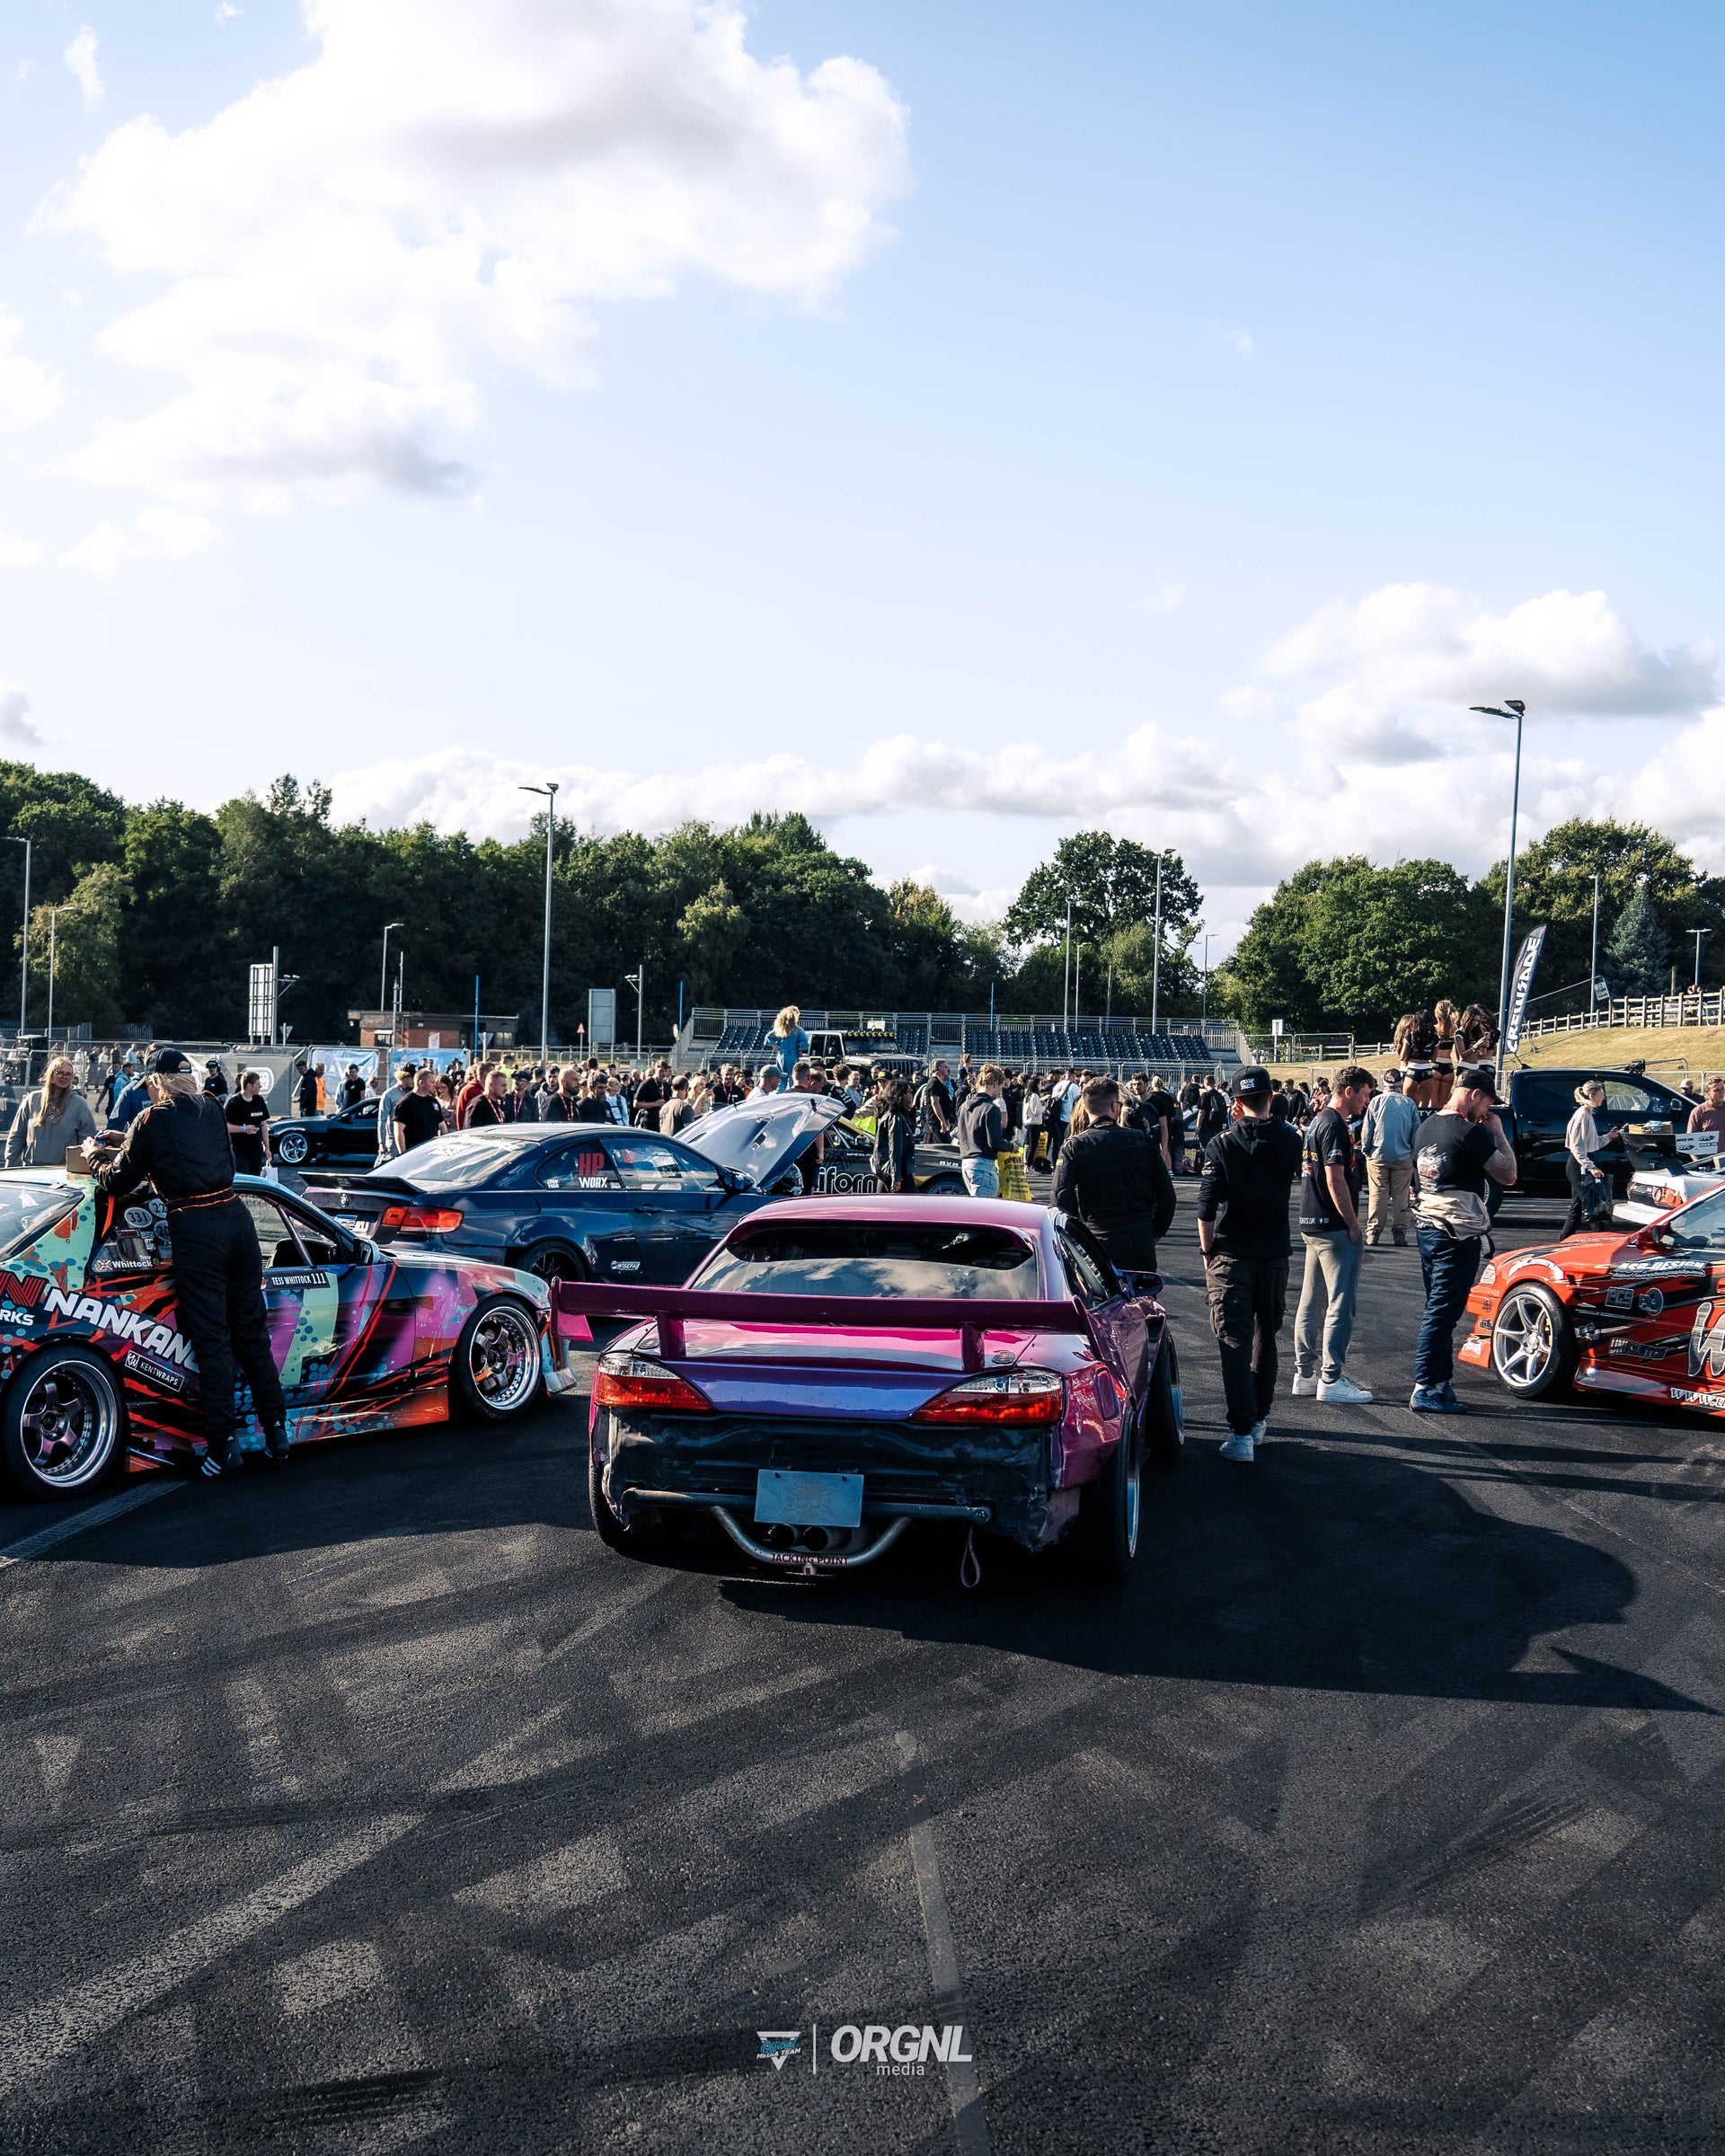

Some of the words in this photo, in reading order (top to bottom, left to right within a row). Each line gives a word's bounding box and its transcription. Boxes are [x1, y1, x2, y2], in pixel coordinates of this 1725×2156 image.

[579, 1153, 605, 1177] HP
[579, 1177, 607, 1188] WORX
[128, 1211, 149, 1223] 331
[111, 1259, 153, 1269] Whittock
[271, 1277, 285, 1286] TESS
[284, 1275, 312, 1285] WHITTOCK
[311, 1273, 326, 1284] 111
[140, 1361, 179, 1386] KENTWRAPS
[771, 1552, 814, 1564] JACKING
[817, 1555, 850, 1565] POINT
